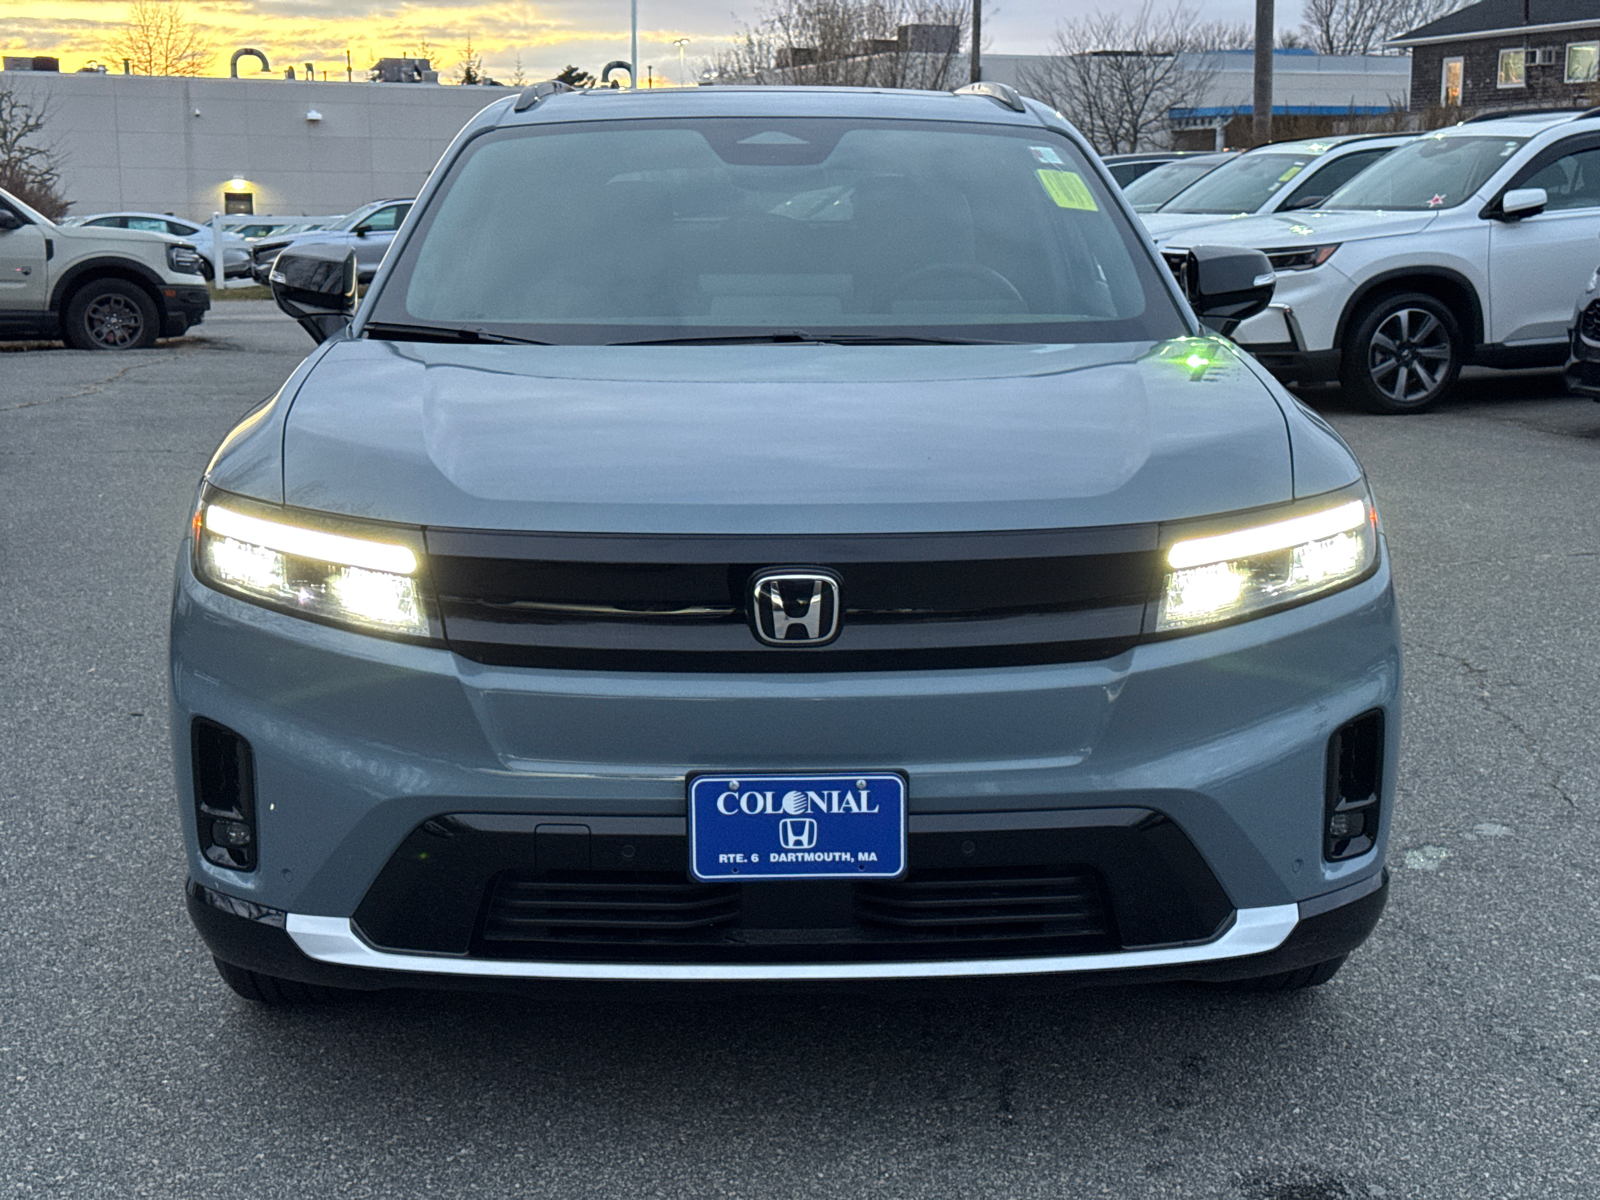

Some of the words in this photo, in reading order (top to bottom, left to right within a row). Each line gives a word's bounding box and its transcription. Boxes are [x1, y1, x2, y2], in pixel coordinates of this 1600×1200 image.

[716, 790, 880, 815] COLONIAL
[718, 853, 748, 864] RTE.
[750, 853, 760, 863] 6
[769, 852, 855, 863] DARTMOUTH,
[857, 851, 878, 862] MA
